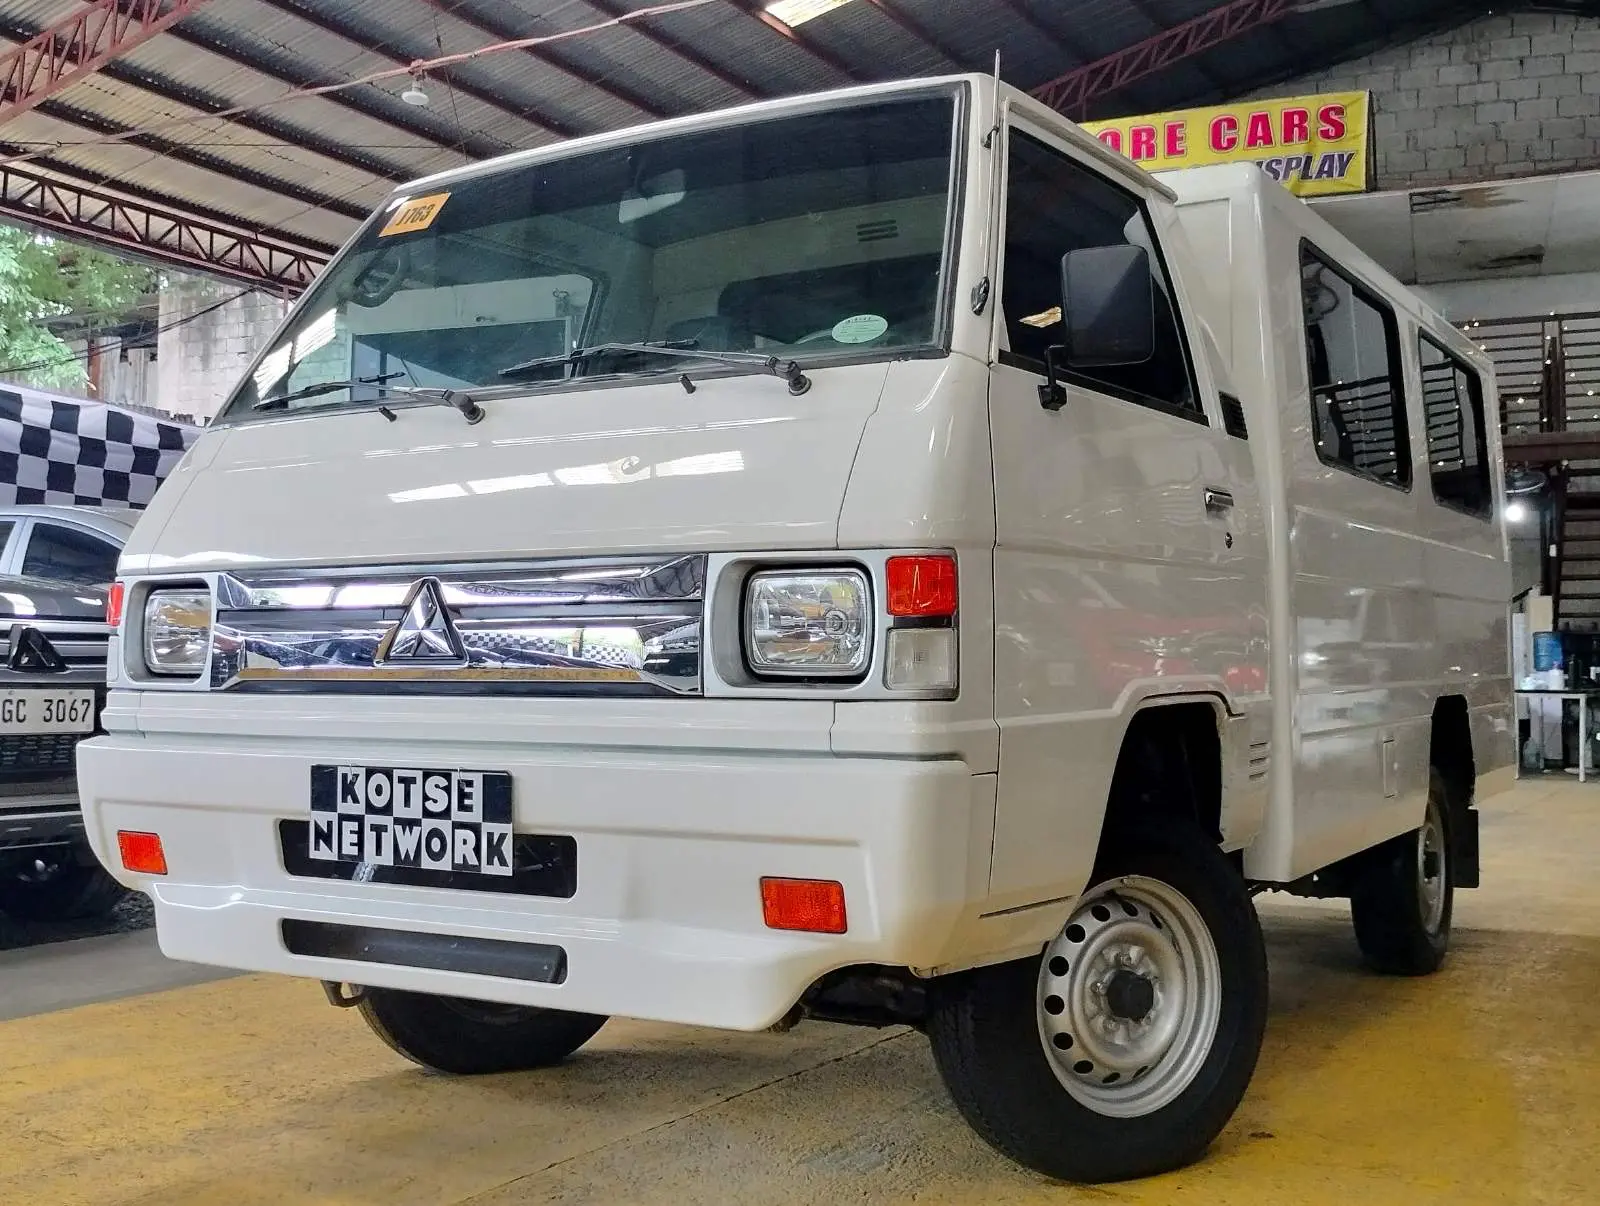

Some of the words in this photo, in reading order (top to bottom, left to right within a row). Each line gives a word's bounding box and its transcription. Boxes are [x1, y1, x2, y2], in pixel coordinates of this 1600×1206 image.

[1096, 120, 1188, 161] ORE
[1208, 104, 1347, 153] CARS
[1257, 152, 1354, 184] SPLAY
[2, 698, 27, 723] GC
[43, 698, 91, 723] 3067
[340, 772, 475, 813] KOTSE
[313, 819, 510, 868] NETWORK
